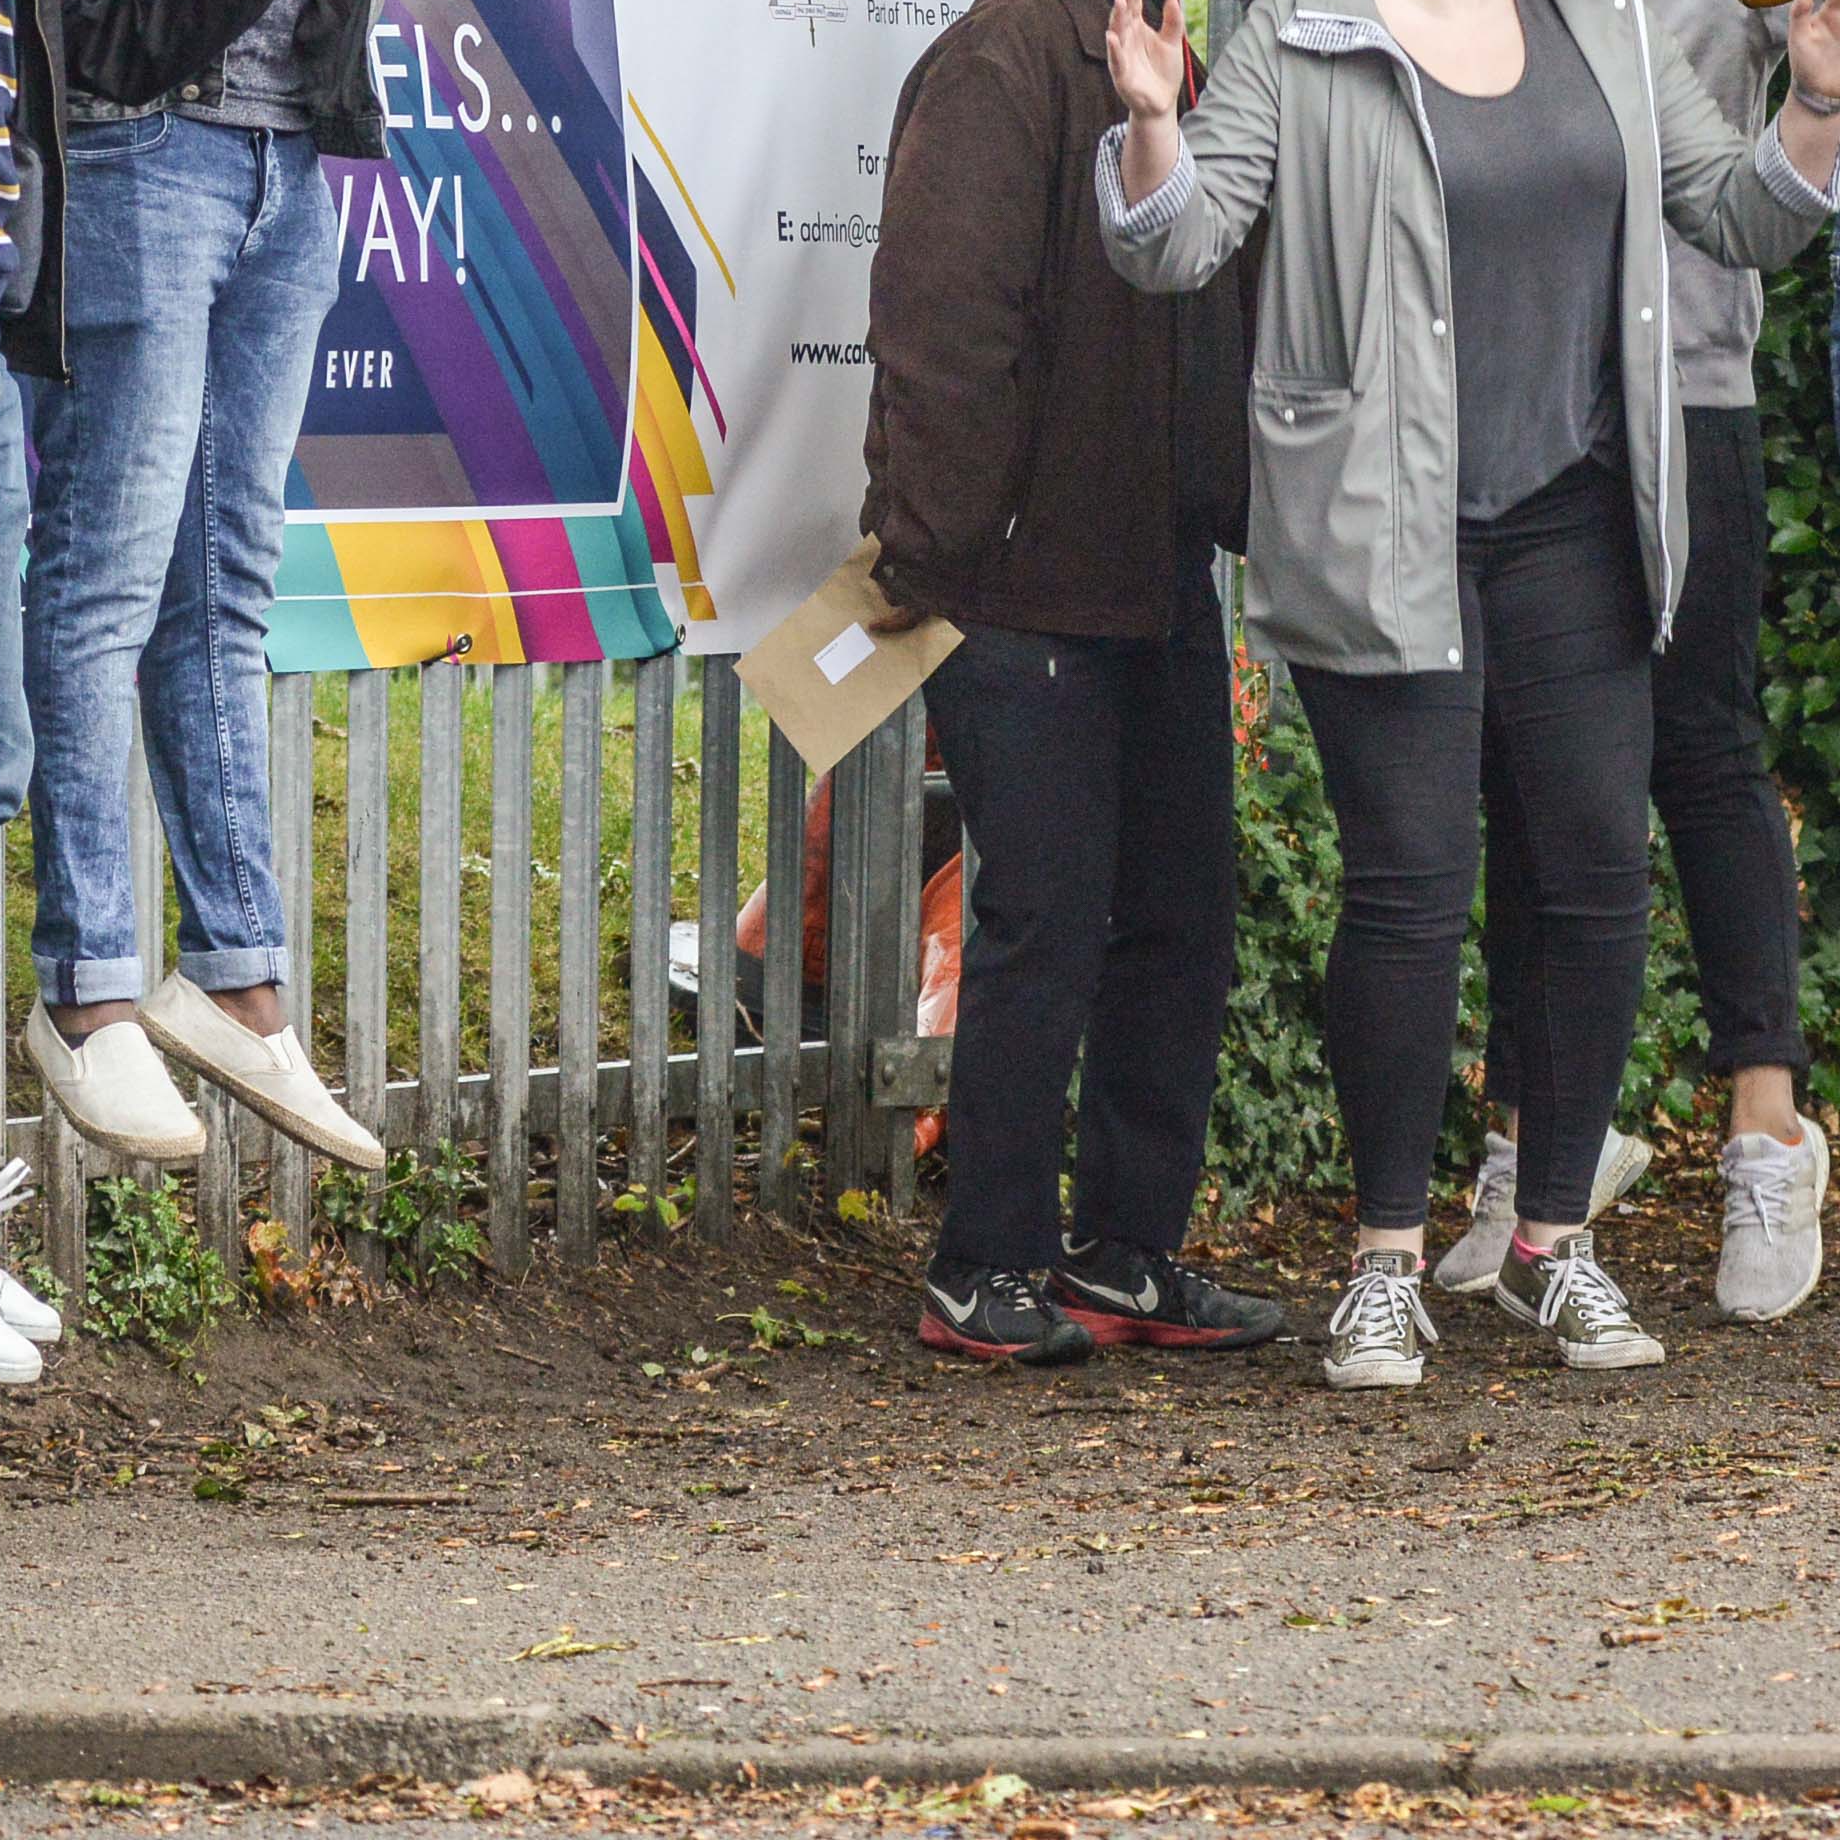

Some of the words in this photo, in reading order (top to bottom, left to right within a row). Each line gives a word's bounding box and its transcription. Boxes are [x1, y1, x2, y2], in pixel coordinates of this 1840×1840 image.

[889, 0, 900, 25] of
[899, 1, 936, 26] The
[941, 2, 964, 26] Ro
[857, 144, 880, 175] For
[777, 211, 794, 242] E:
[325, 349, 394, 389] EVER
